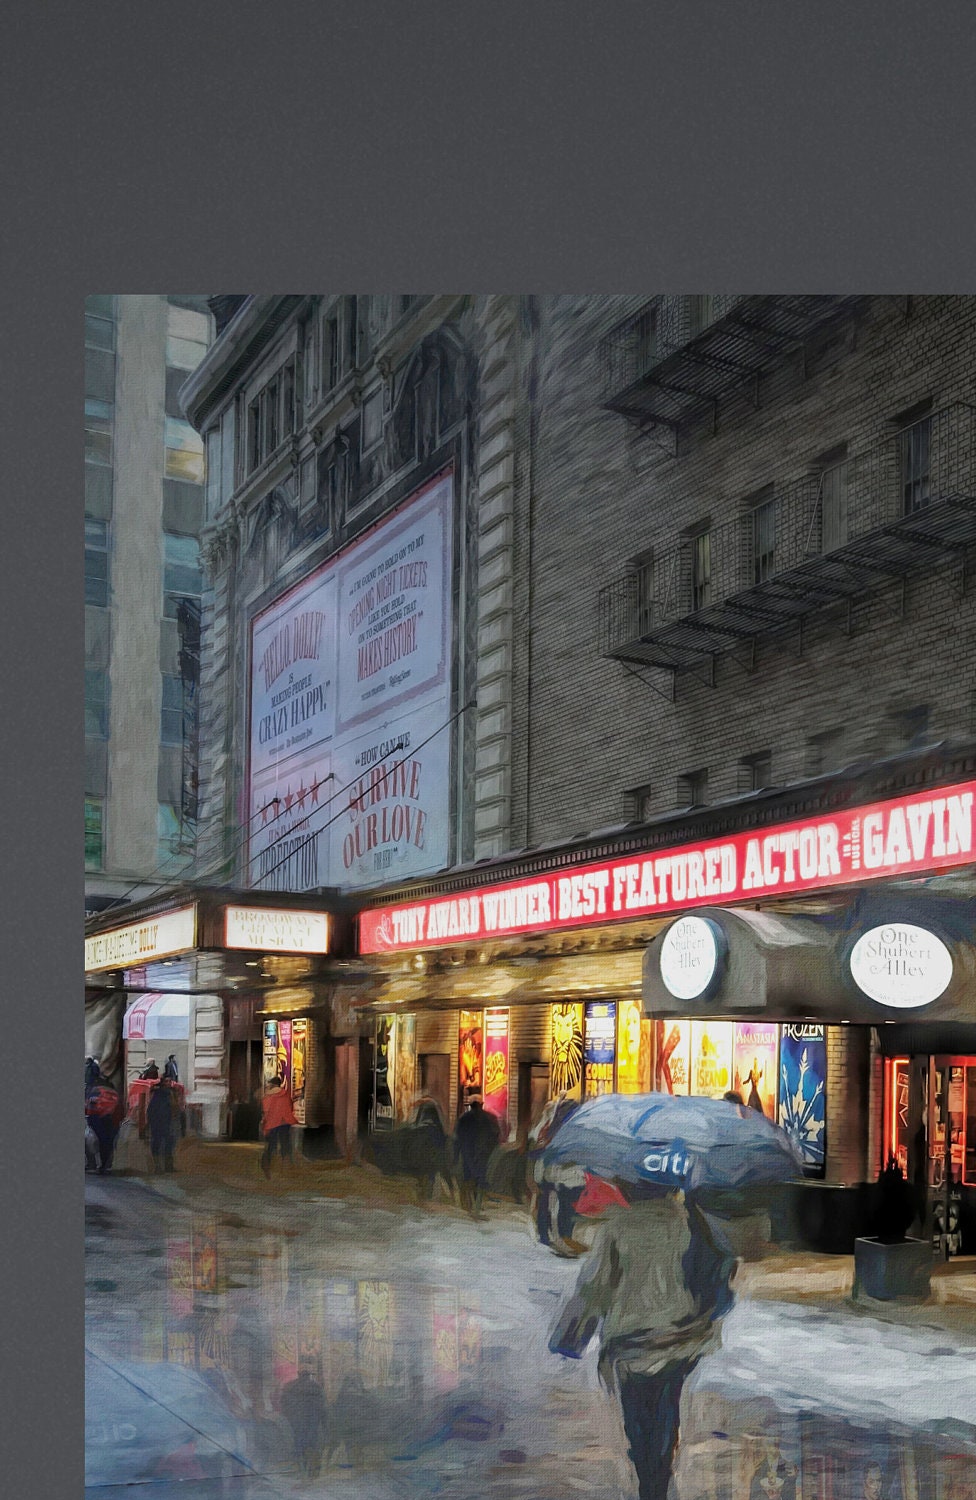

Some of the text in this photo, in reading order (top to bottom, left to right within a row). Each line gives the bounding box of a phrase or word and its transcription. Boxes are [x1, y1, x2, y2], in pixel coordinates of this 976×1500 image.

[408, 540, 415, 554] TO
[415, 534, 425, 548] MY
[376, 569, 397, 605] NIGHT
[368, 594, 405, 625] LIKE YOU HOLD
[373, 609, 403, 635] SOMETHING
[403, 599, 416, 616] THAT
[357, 636, 383, 682] MAKES
[272, 673, 312, 708] MAKING PEOPLE
[259, 705, 289, 745] CRAZY
[380, 738, 397, 757] CAN
[398, 731, 410, 748] WE
[349, 760, 422, 823] SURVIVE
[343, 804, 427, 869] OUR LOVE
[851, 816, 860, 870] MUSICAL
[863, 792, 974, 869] GAVIN
[558, 822, 841, 920] BEST FEATURED ACTOR
[392, 904, 427, 944] TONY
[482, 882, 551, 930] WINNER
[677, 922, 697, 938] One
[670, 936, 705, 951] Shubert
[866, 941, 931, 959] Shubert
[881, 927, 919, 945] One
[870, 958, 927, 976] Alley
[782, 1024, 824, 1041] FROZEN
[585, 1063, 613, 1080] COME
